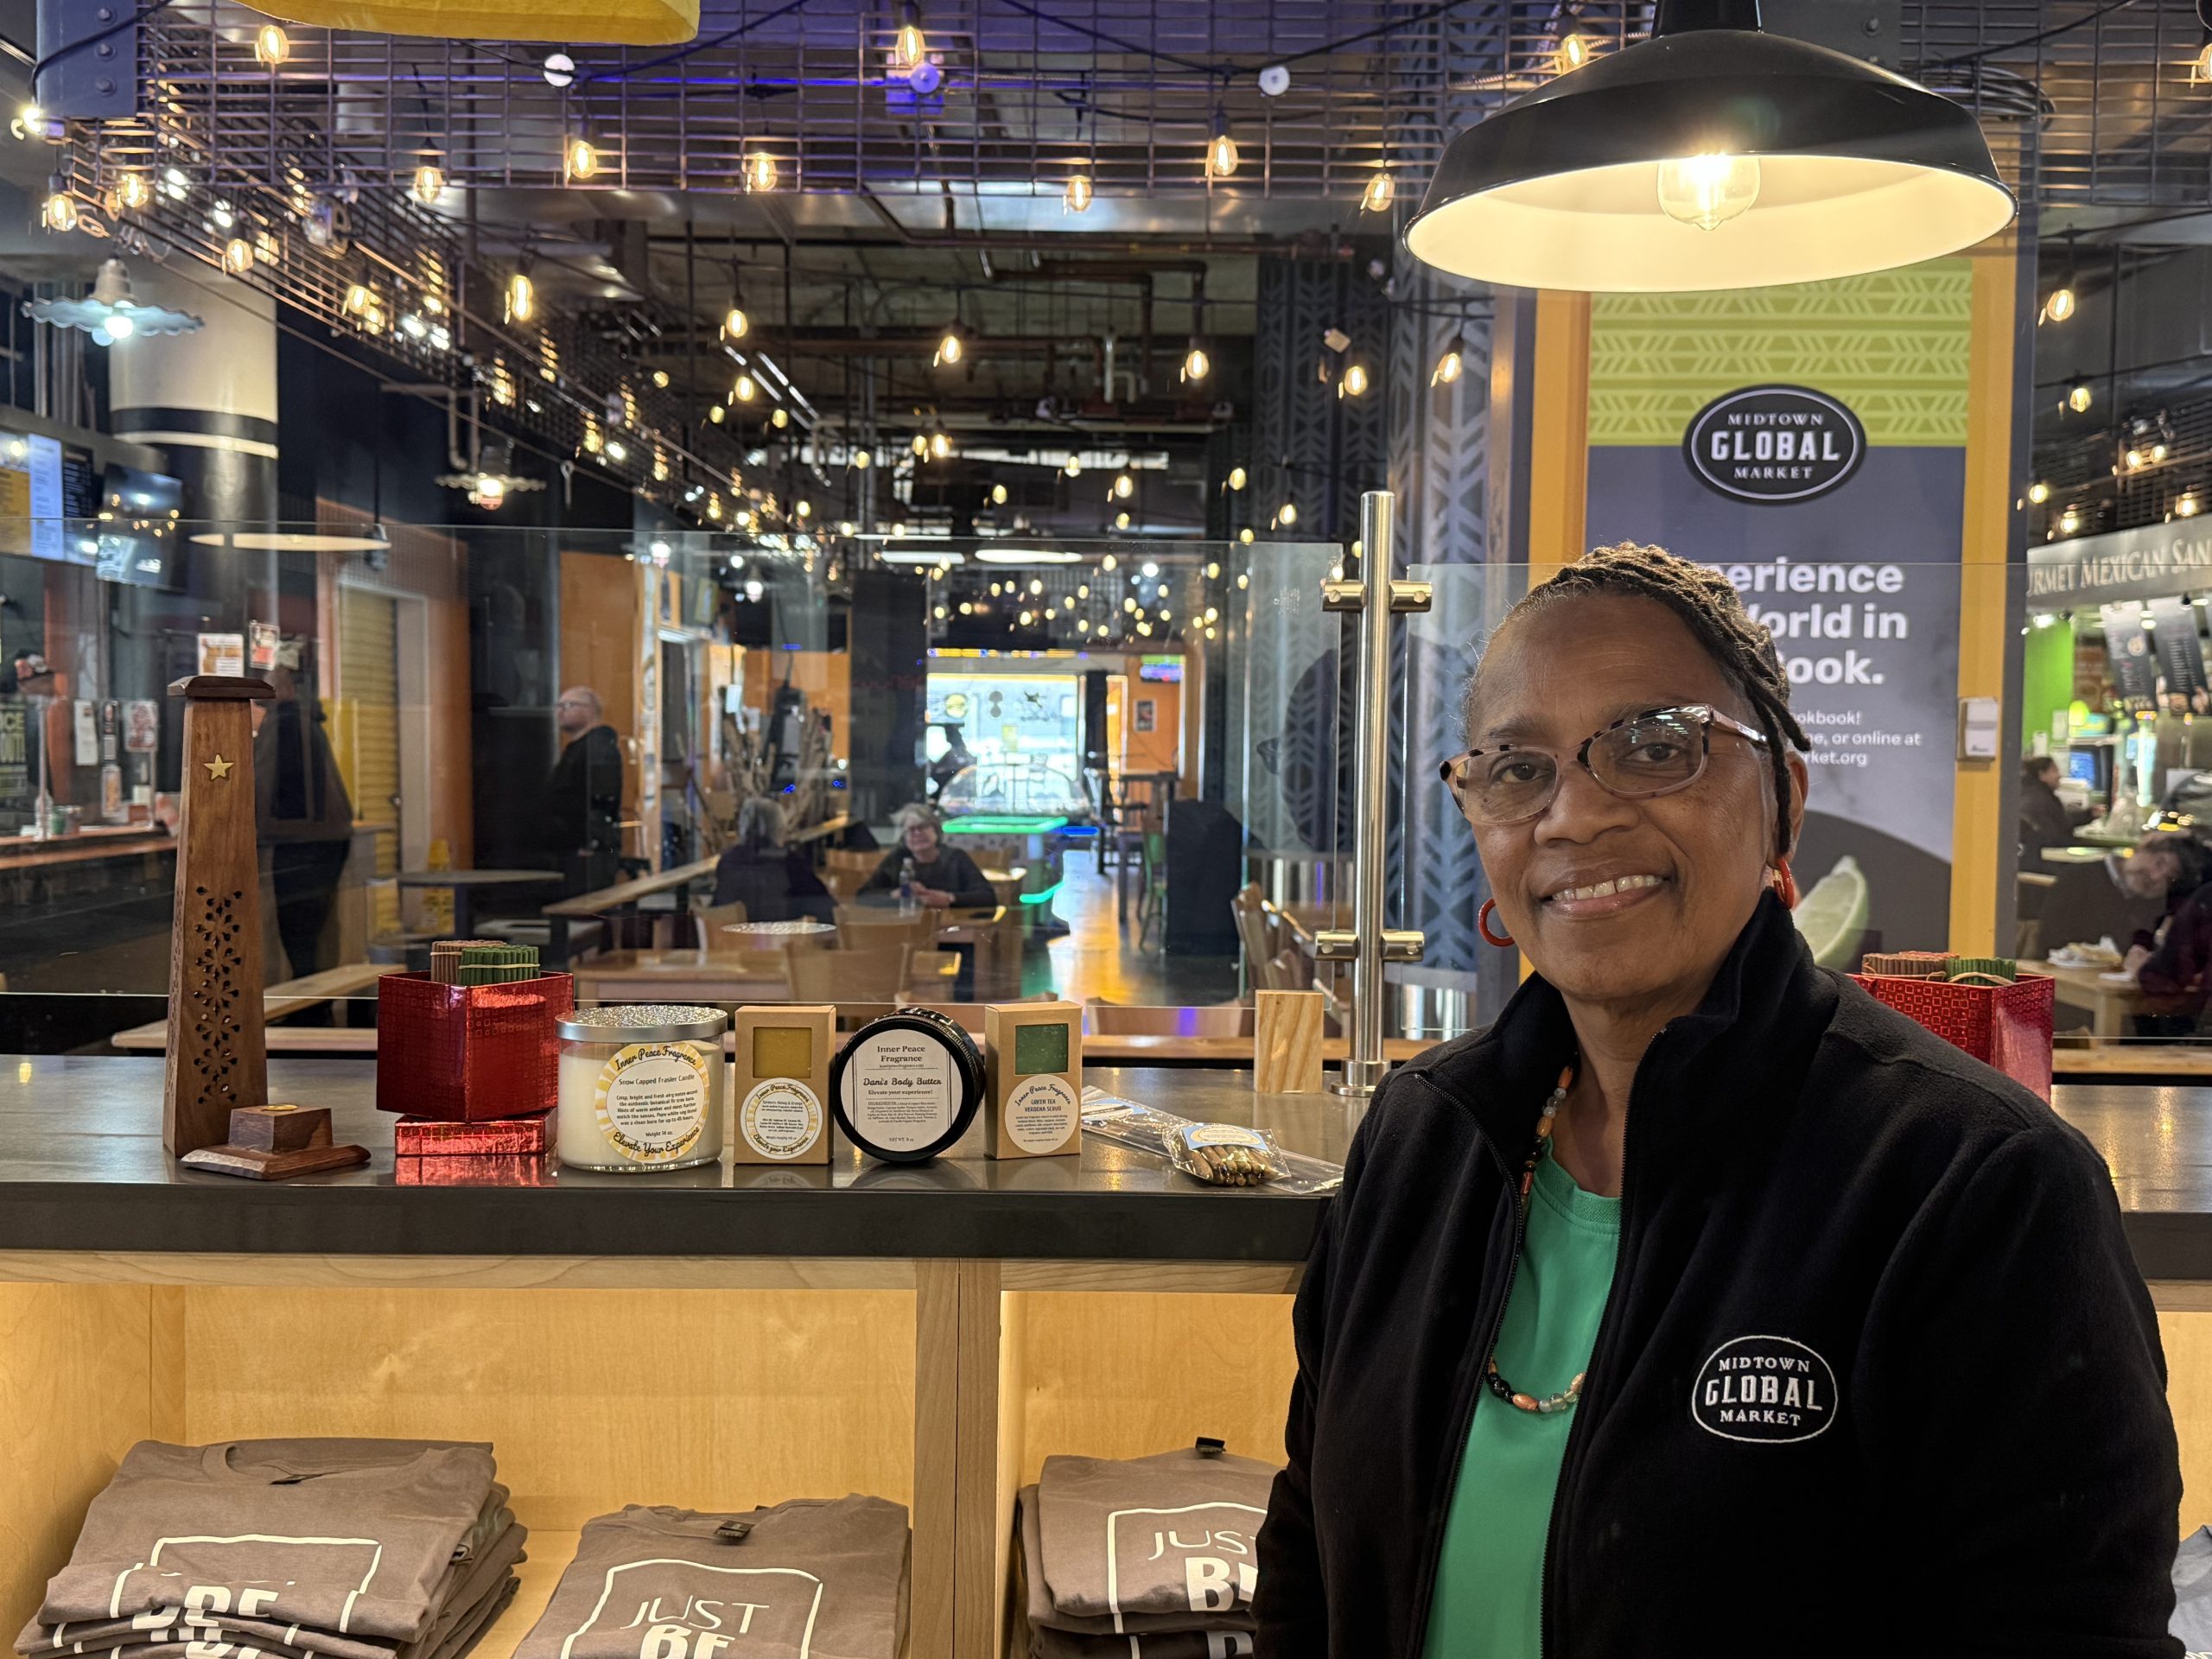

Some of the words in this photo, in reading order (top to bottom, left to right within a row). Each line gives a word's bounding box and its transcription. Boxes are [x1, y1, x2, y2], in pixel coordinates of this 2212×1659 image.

[1727, 412, 1824, 426] MIDTOWN
[1710, 431, 1840, 461] GLOBAL
[1734, 467, 1813, 480] MARKET
[1707, 556, 1904, 593] erience
[2081, 546, 2165, 588] MEXICAN
[1864, 603, 1907, 639] in
[1777, 649, 1885, 684] ook.
[1793, 710, 1861, 725] okbook!
[1832, 734, 1848, 745] or
[1852, 730, 1901, 746] online
[1904, 732, 1922, 746] at
[1803, 752, 1867, 766] rket.org
[615, 1055, 637, 1071] Inner
[638, 1048, 661, 1060] Peace
[663, 1046, 696, 1065] Fragrance
[880, 1055, 923, 1064] Fragrance
[891, 1077, 913, 1088] Body
[1014, 1092, 1030, 1106] Inner
[1029, 1085, 1047, 1094] Peace
[1048, 1084, 1071, 1105] Fragrance
[613, 1131, 642, 1152] Elevate
[642, 1142, 664, 1157] Your
[665, 1126, 700, 1154] Experience
[1719, 1356, 1810, 1372] MIDTOWN
[1705, 1375, 1823, 1411] GLOBAL
[1719, 1409, 1801, 1426] MARKET
[1148, 1530, 1256, 1560] JUS
[620, 1595, 770, 1635] JUST
